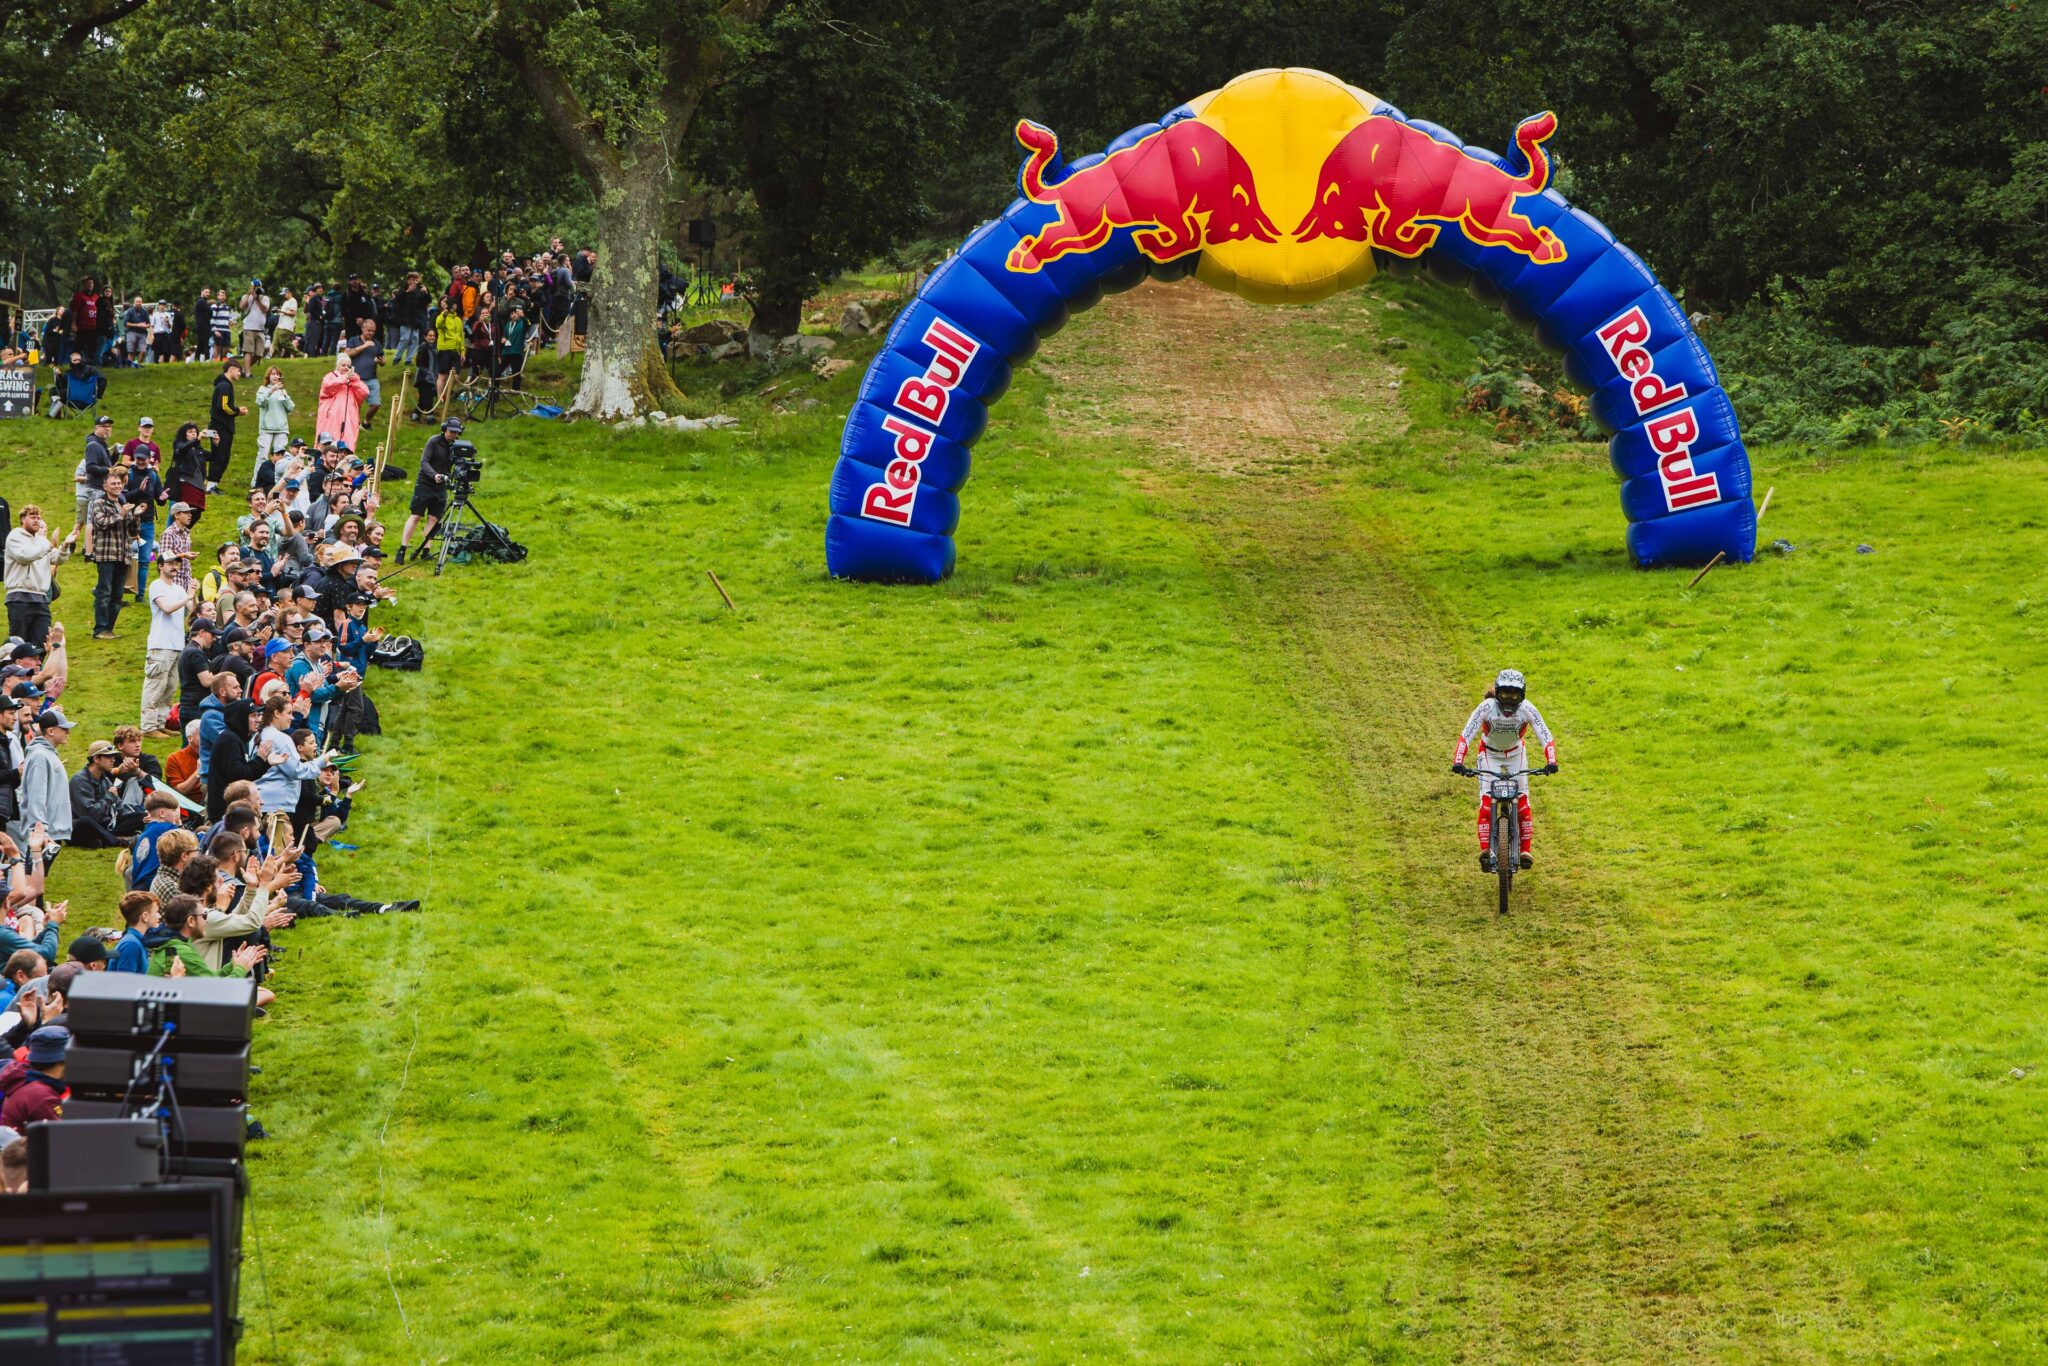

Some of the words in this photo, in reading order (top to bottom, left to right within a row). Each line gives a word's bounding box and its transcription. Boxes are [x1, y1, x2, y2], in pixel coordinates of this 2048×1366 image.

[893, 316, 981, 426] Bull
[1595, 305, 1688, 416] Red
[1643, 406, 1722, 512] Bull
[860, 414, 936, 527] Red
[1501, 789, 1508, 798] 8
